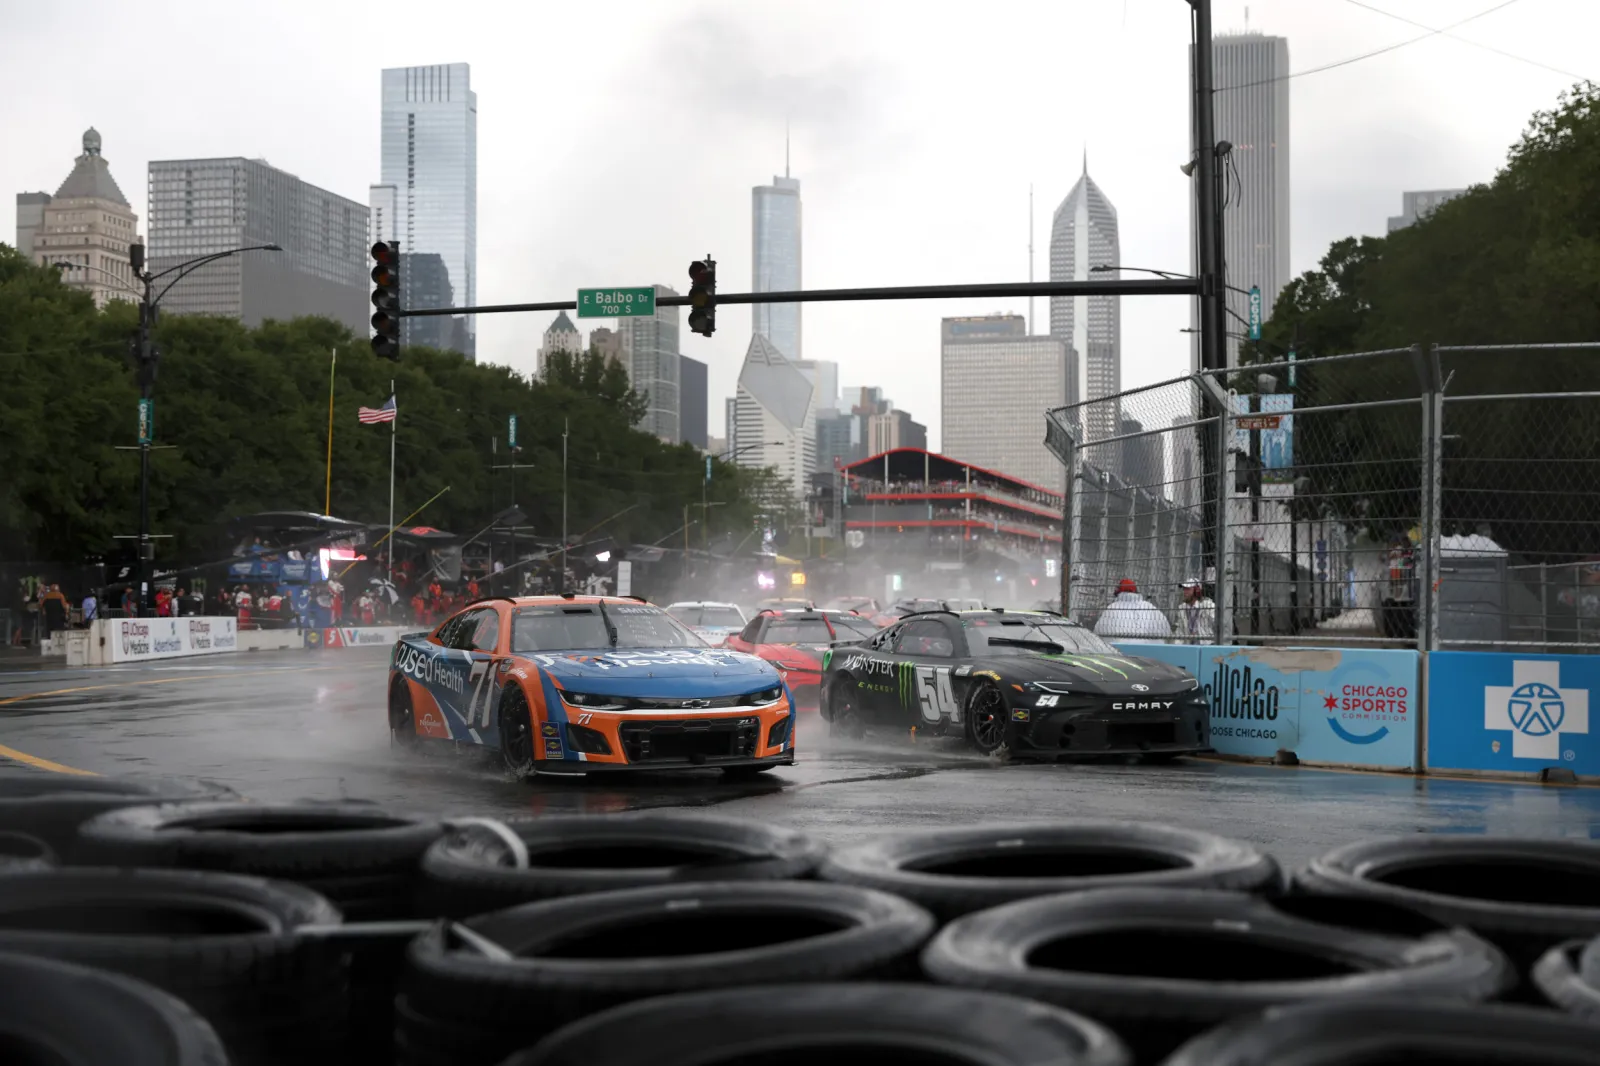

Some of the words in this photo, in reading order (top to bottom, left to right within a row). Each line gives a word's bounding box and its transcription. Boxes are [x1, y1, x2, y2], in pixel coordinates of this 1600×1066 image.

[583, 295, 590, 304] E
[595, 291, 633, 304] Balbo
[638, 294, 649, 303] Dr
[601, 305, 620, 314] 700
[625, 305, 632, 313] S
[434, 661, 464, 695] Health
[858, 681, 895, 693] ENERGY
[1342, 685, 1408, 699] CHICAGO
[467, 659, 499, 729] 71
[914, 664, 961, 725] 54
[1035, 695, 1061, 708] 54
[1112, 701, 1175, 711] CAMRY
[1342, 698, 1408, 714] SPORTS
[577, 713, 594, 725] 71
[1342, 713, 1408, 722] COMMISSION
[1209, 726, 1234, 738] OOSE
[1236, 728, 1278, 740] CHICAGO
